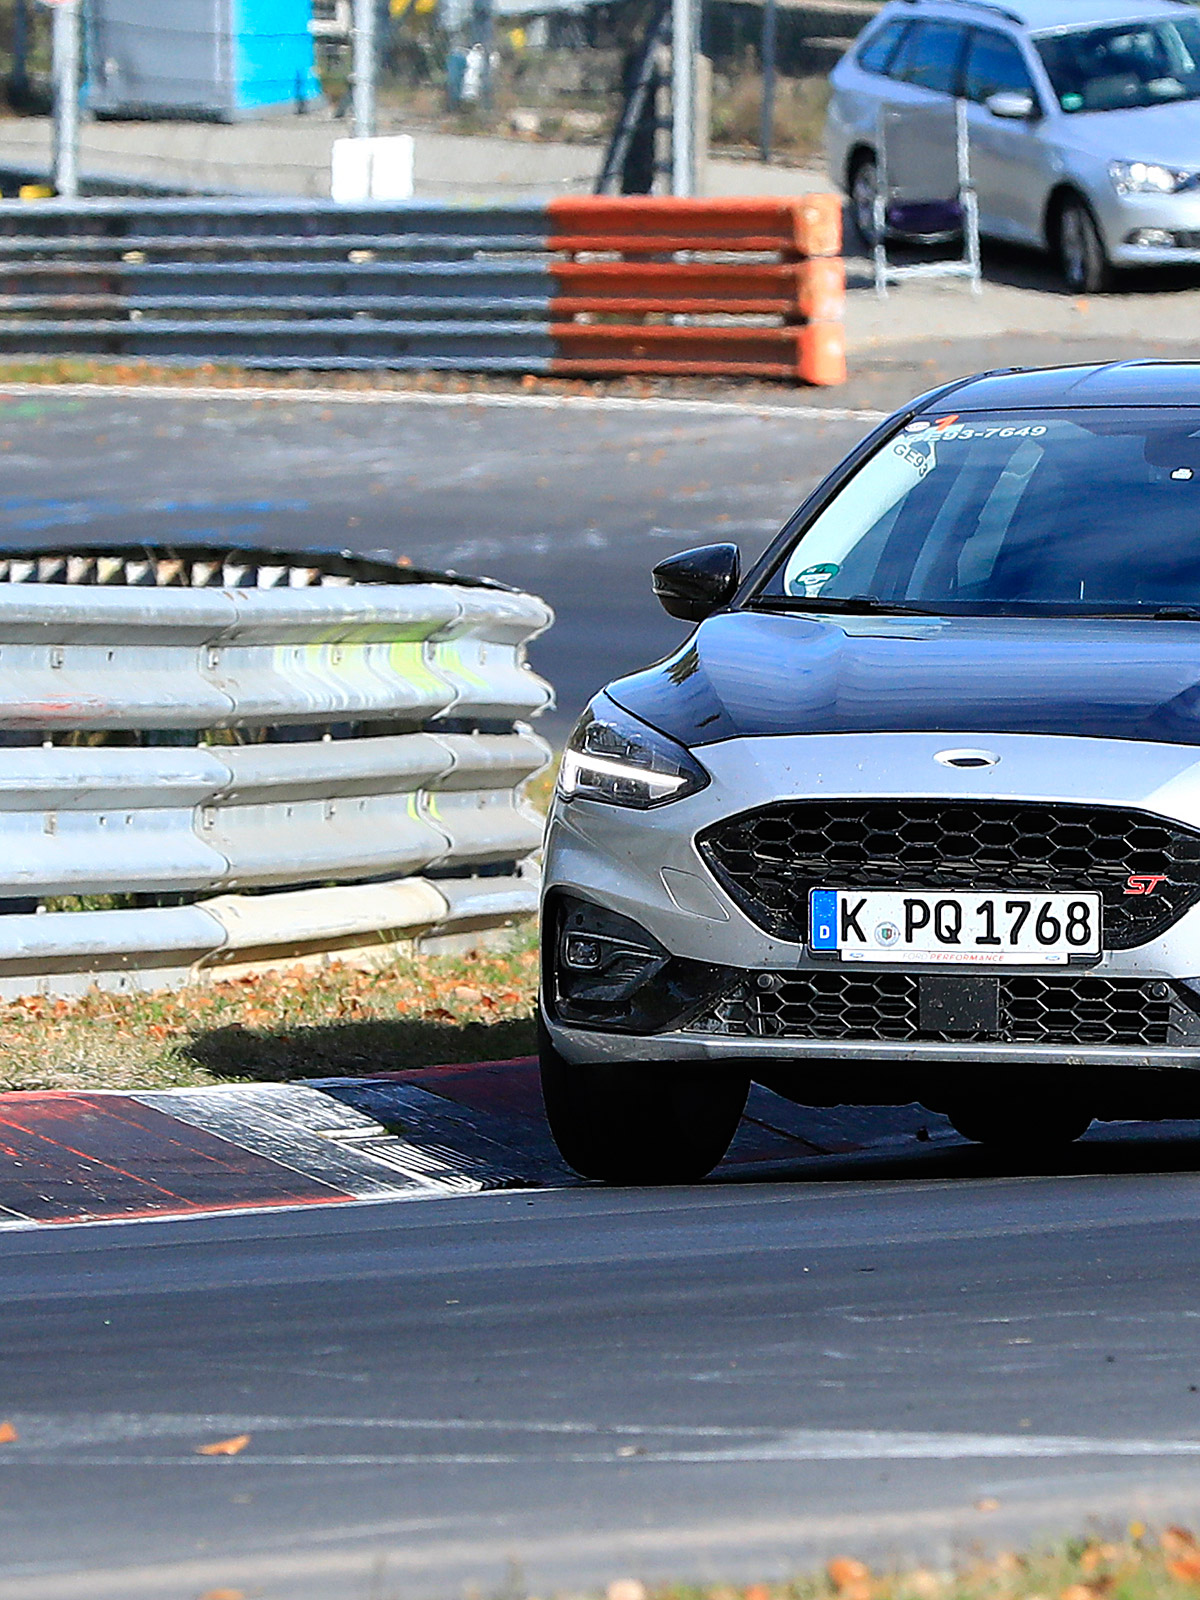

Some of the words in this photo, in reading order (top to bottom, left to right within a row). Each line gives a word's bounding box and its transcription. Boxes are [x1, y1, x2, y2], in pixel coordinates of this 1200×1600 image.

[1123, 875, 1167, 895] ST
[841, 898, 868, 943] K
[903, 898, 962, 944] PQ
[975, 900, 1092, 946] 1768
[819, 925, 831, 939] D
[929, 953, 1005, 962] PERFORMANCE
